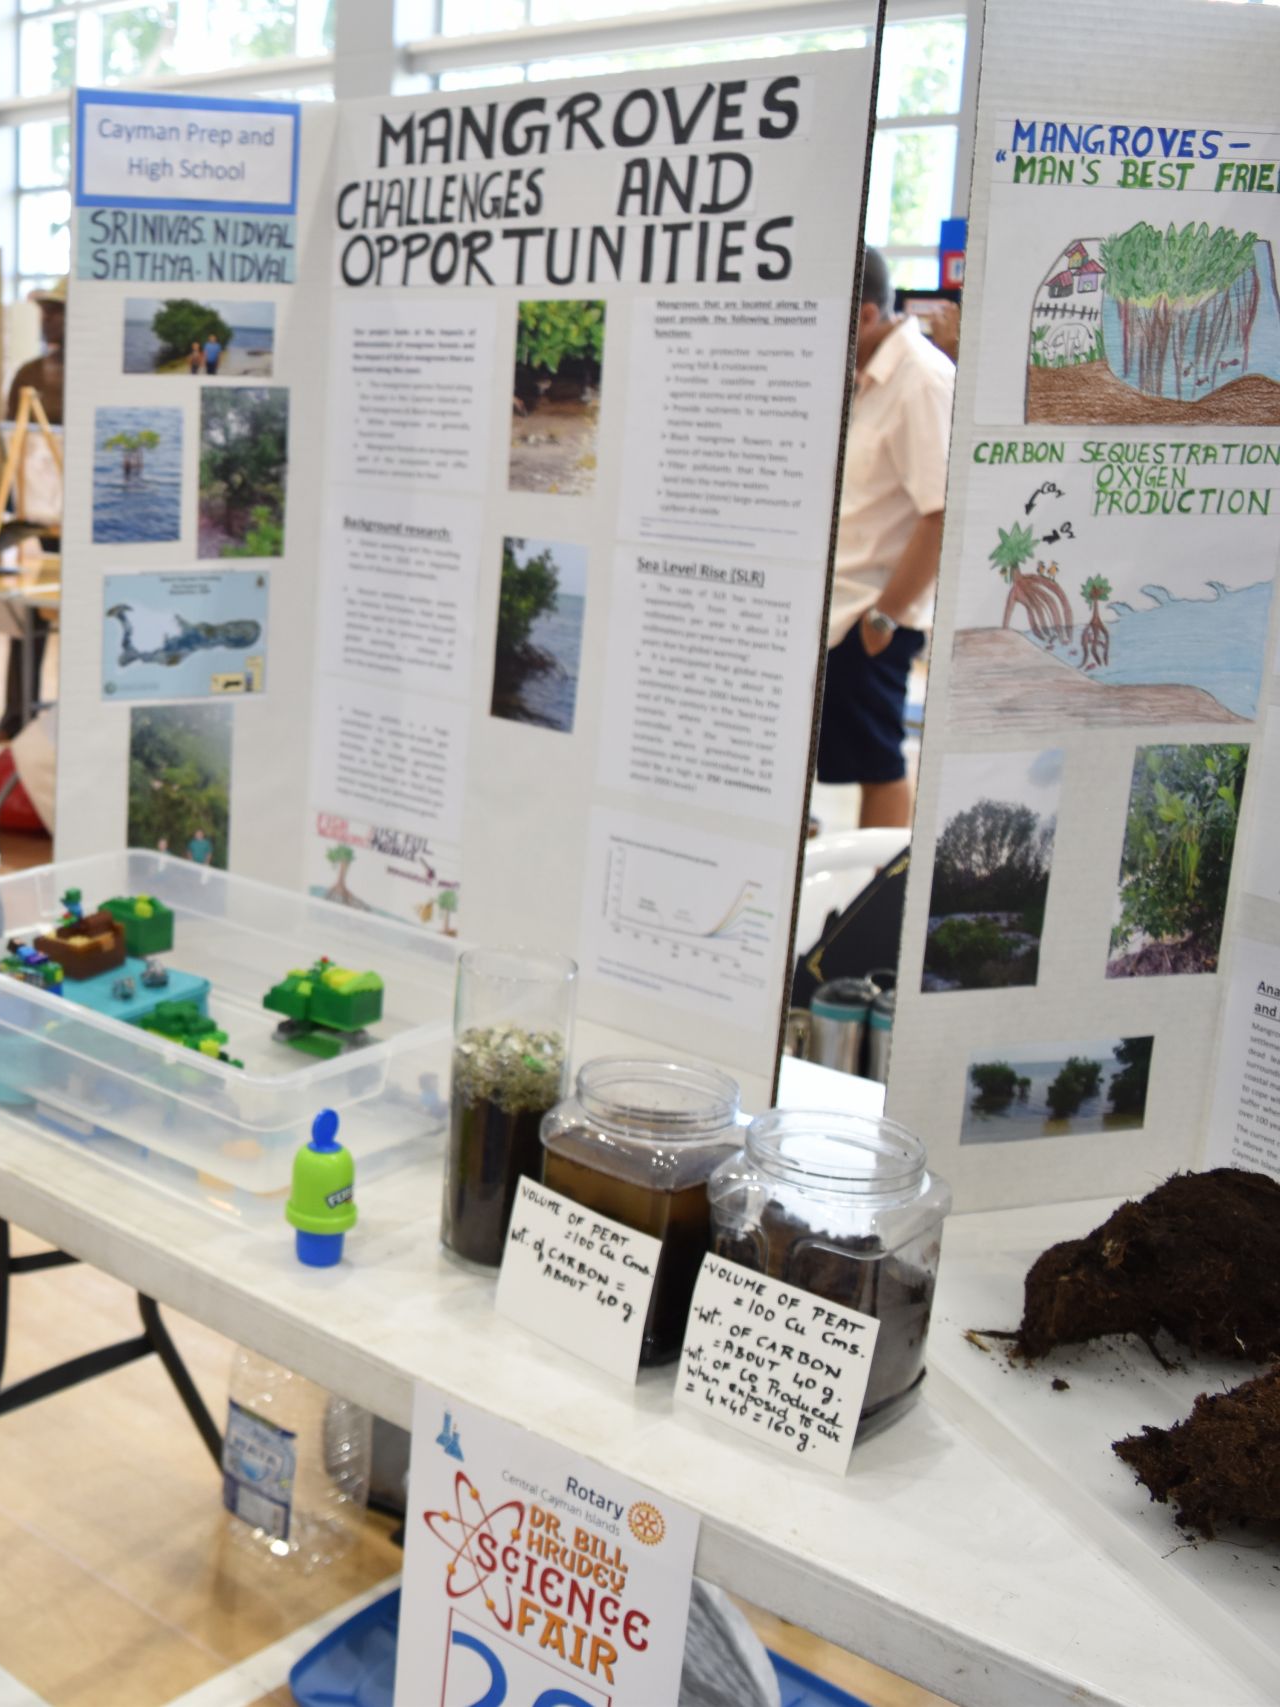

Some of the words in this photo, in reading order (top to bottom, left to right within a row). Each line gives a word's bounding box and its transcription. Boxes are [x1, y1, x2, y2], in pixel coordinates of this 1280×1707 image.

[98, 118, 180, 142] Cayman
[187, 123, 232, 147] Prep
[239, 127, 275, 146] and
[378, 75, 800, 168] MANGROVES
[128, 157, 173, 181] High
[180, 159, 245, 180] School
[1117, 159, 1194, 190] BEST
[1214, 163, 1280, 194] FRIE
[337, 167, 544, 231] CHALLENGES
[617, 151, 754, 217] AND
[341, 216, 794, 288] OPPORTUNITIES
[732, 315, 769, 325] following
[774, 316, 817, 325] important
[776, 301, 799, 310] along
[804, 301, 818, 309] the
[973, 441, 1065, 465] CARBON
[1079, 441, 1280, 465] SEQUESTRATION
[1096, 464, 1186, 489] OXYGEN
[1093, 487, 1270, 516] PRODUCTION
[344, 515, 402, 531] Background
[637, 556, 660, 571] Sea
[663, 560, 696, 576] Level
[701, 563, 728, 578] Rise
[731, 567, 765, 588] (SLR)
[1254, 1003, 1277, 1017] and
[1256, 1115, 1268, 1125] 100
[521, 1185, 563, 1215] VOLUME
[568, 1213, 585, 1226] OF
[592, 1223, 629, 1247] PEAT
[543, 1264, 588, 1292] ABOUT
[548, 1248, 609, 1285] CARBON
[777, 1293, 800, 1310] OF
[812, 1306, 866, 1334] PEAT
[785, 1317, 806, 1336] Cu
[712, 1360, 732, 1370] OF
[729, 1324, 752, 1337] OF
[756, 1336, 842, 1380] CARBON
[793, 1372, 817, 1389] 40
[767, 1417, 795, 1437] 160
[817, 1424, 840, 1443] air
[501, 1469, 539, 1496] Central
[541, 1488, 582, 1518] Cayman
[585, 1508, 621, 1537] Islands
[566, 1476, 624, 1521] Rotary
[529, 1504, 566, 1543] DR.
[573, 1527, 629, 1573] BILL
[526, 1529, 626, 1598] HRUDEY
[476, 1533, 651, 1652] SCIENCE
[516, 1596, 618, 1685] FAIR
